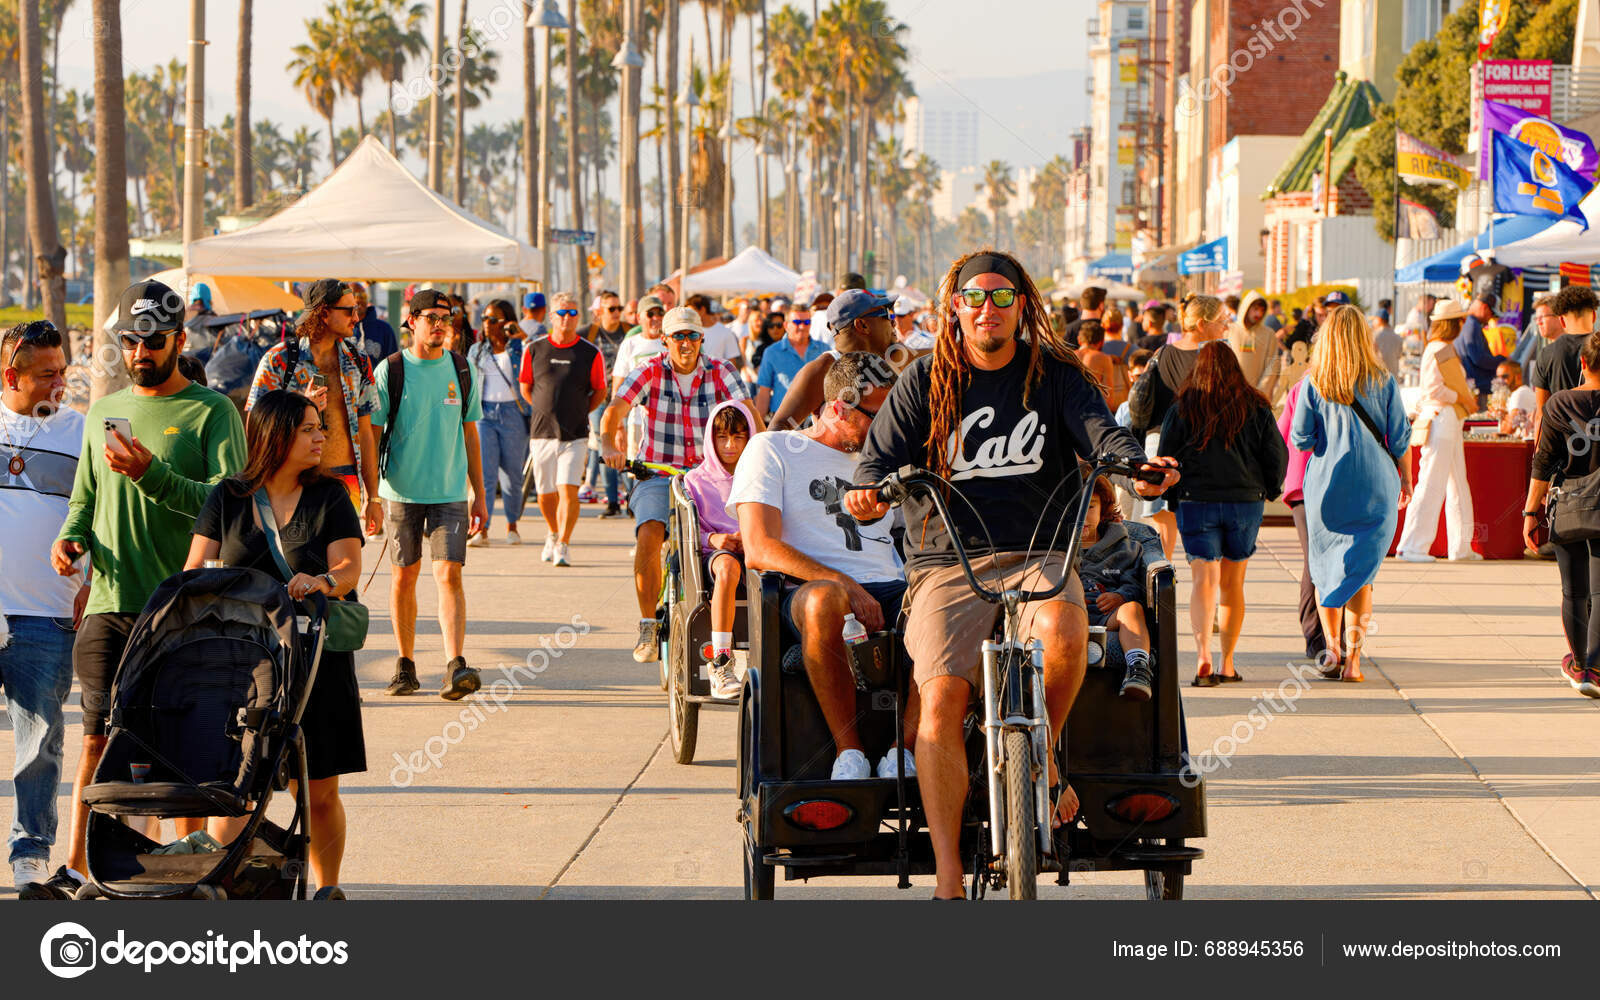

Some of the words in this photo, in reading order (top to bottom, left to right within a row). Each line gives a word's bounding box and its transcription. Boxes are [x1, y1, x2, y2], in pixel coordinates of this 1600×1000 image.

[1485, 64, 1512, 80] FOR
[1513, 64, 1550, 80] LEASE
[134, 298, 155, 309] NIKE
[947, 405, 1047, 473] Cali
